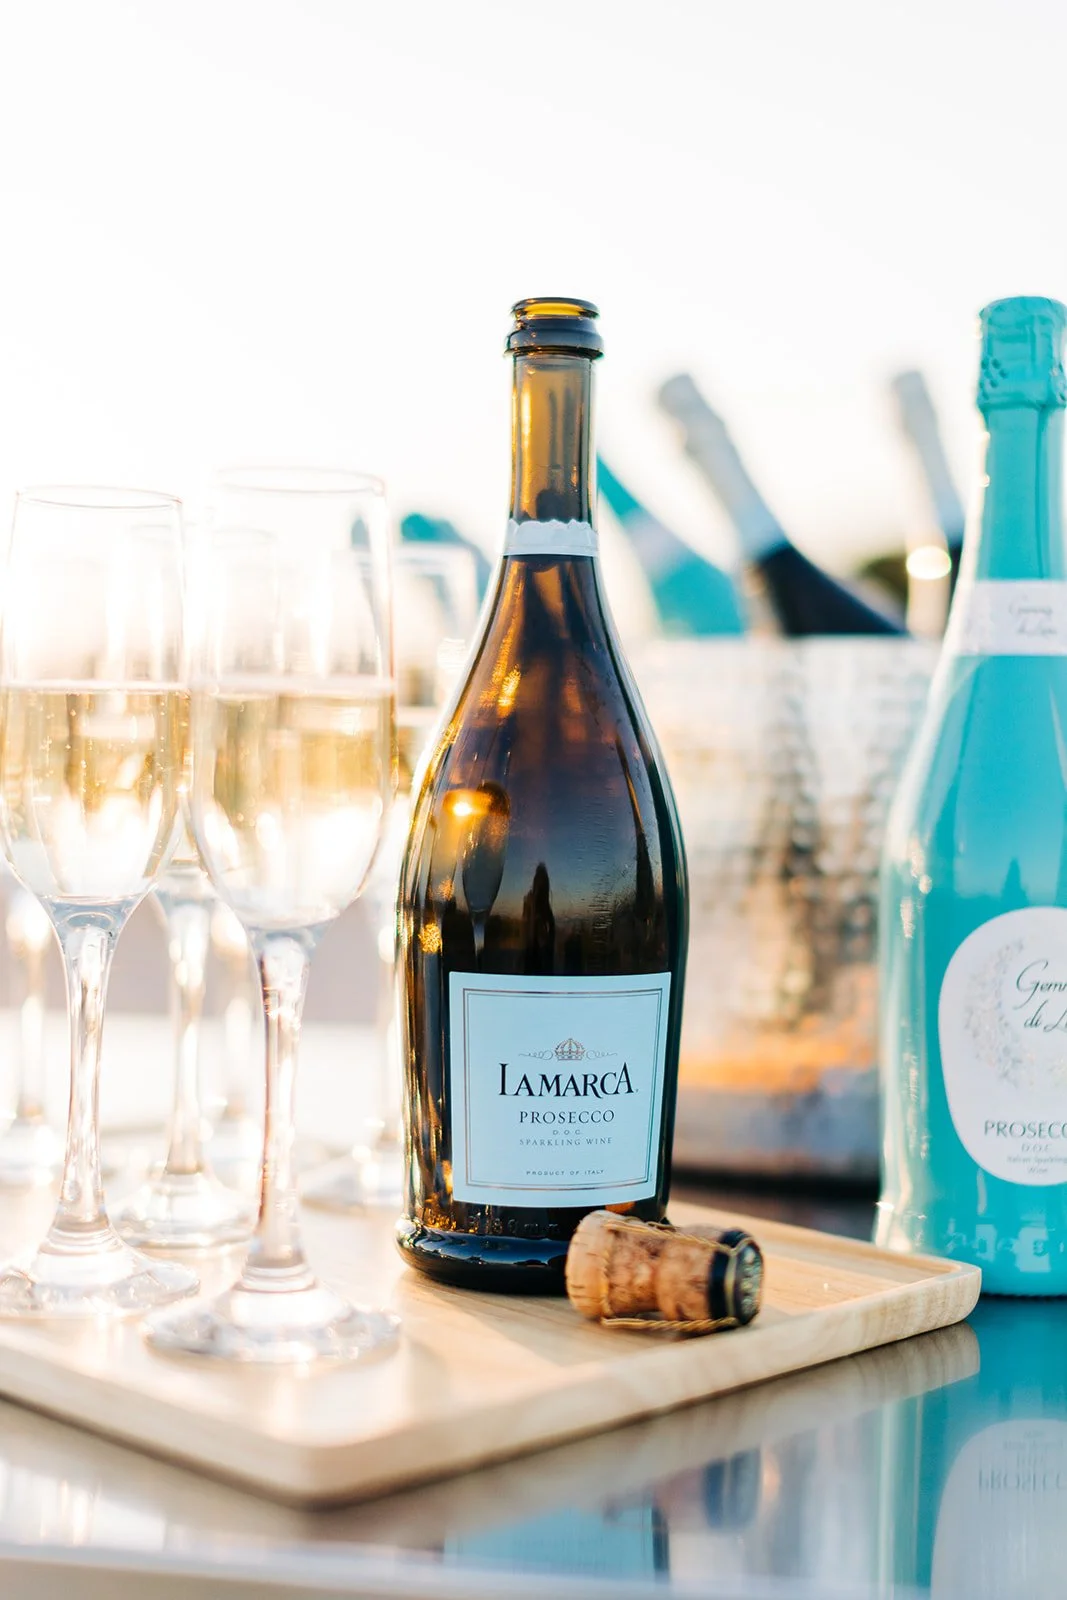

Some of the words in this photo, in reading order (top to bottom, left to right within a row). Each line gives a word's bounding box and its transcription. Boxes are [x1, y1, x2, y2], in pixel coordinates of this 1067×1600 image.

[1023, 999, 1043, 1029] di
[519, 1109, 615, 1125] PROSECCO
[519, 1138, 581, 1147] SPARKLING
[586, 1136, 613, 1145] WINE
